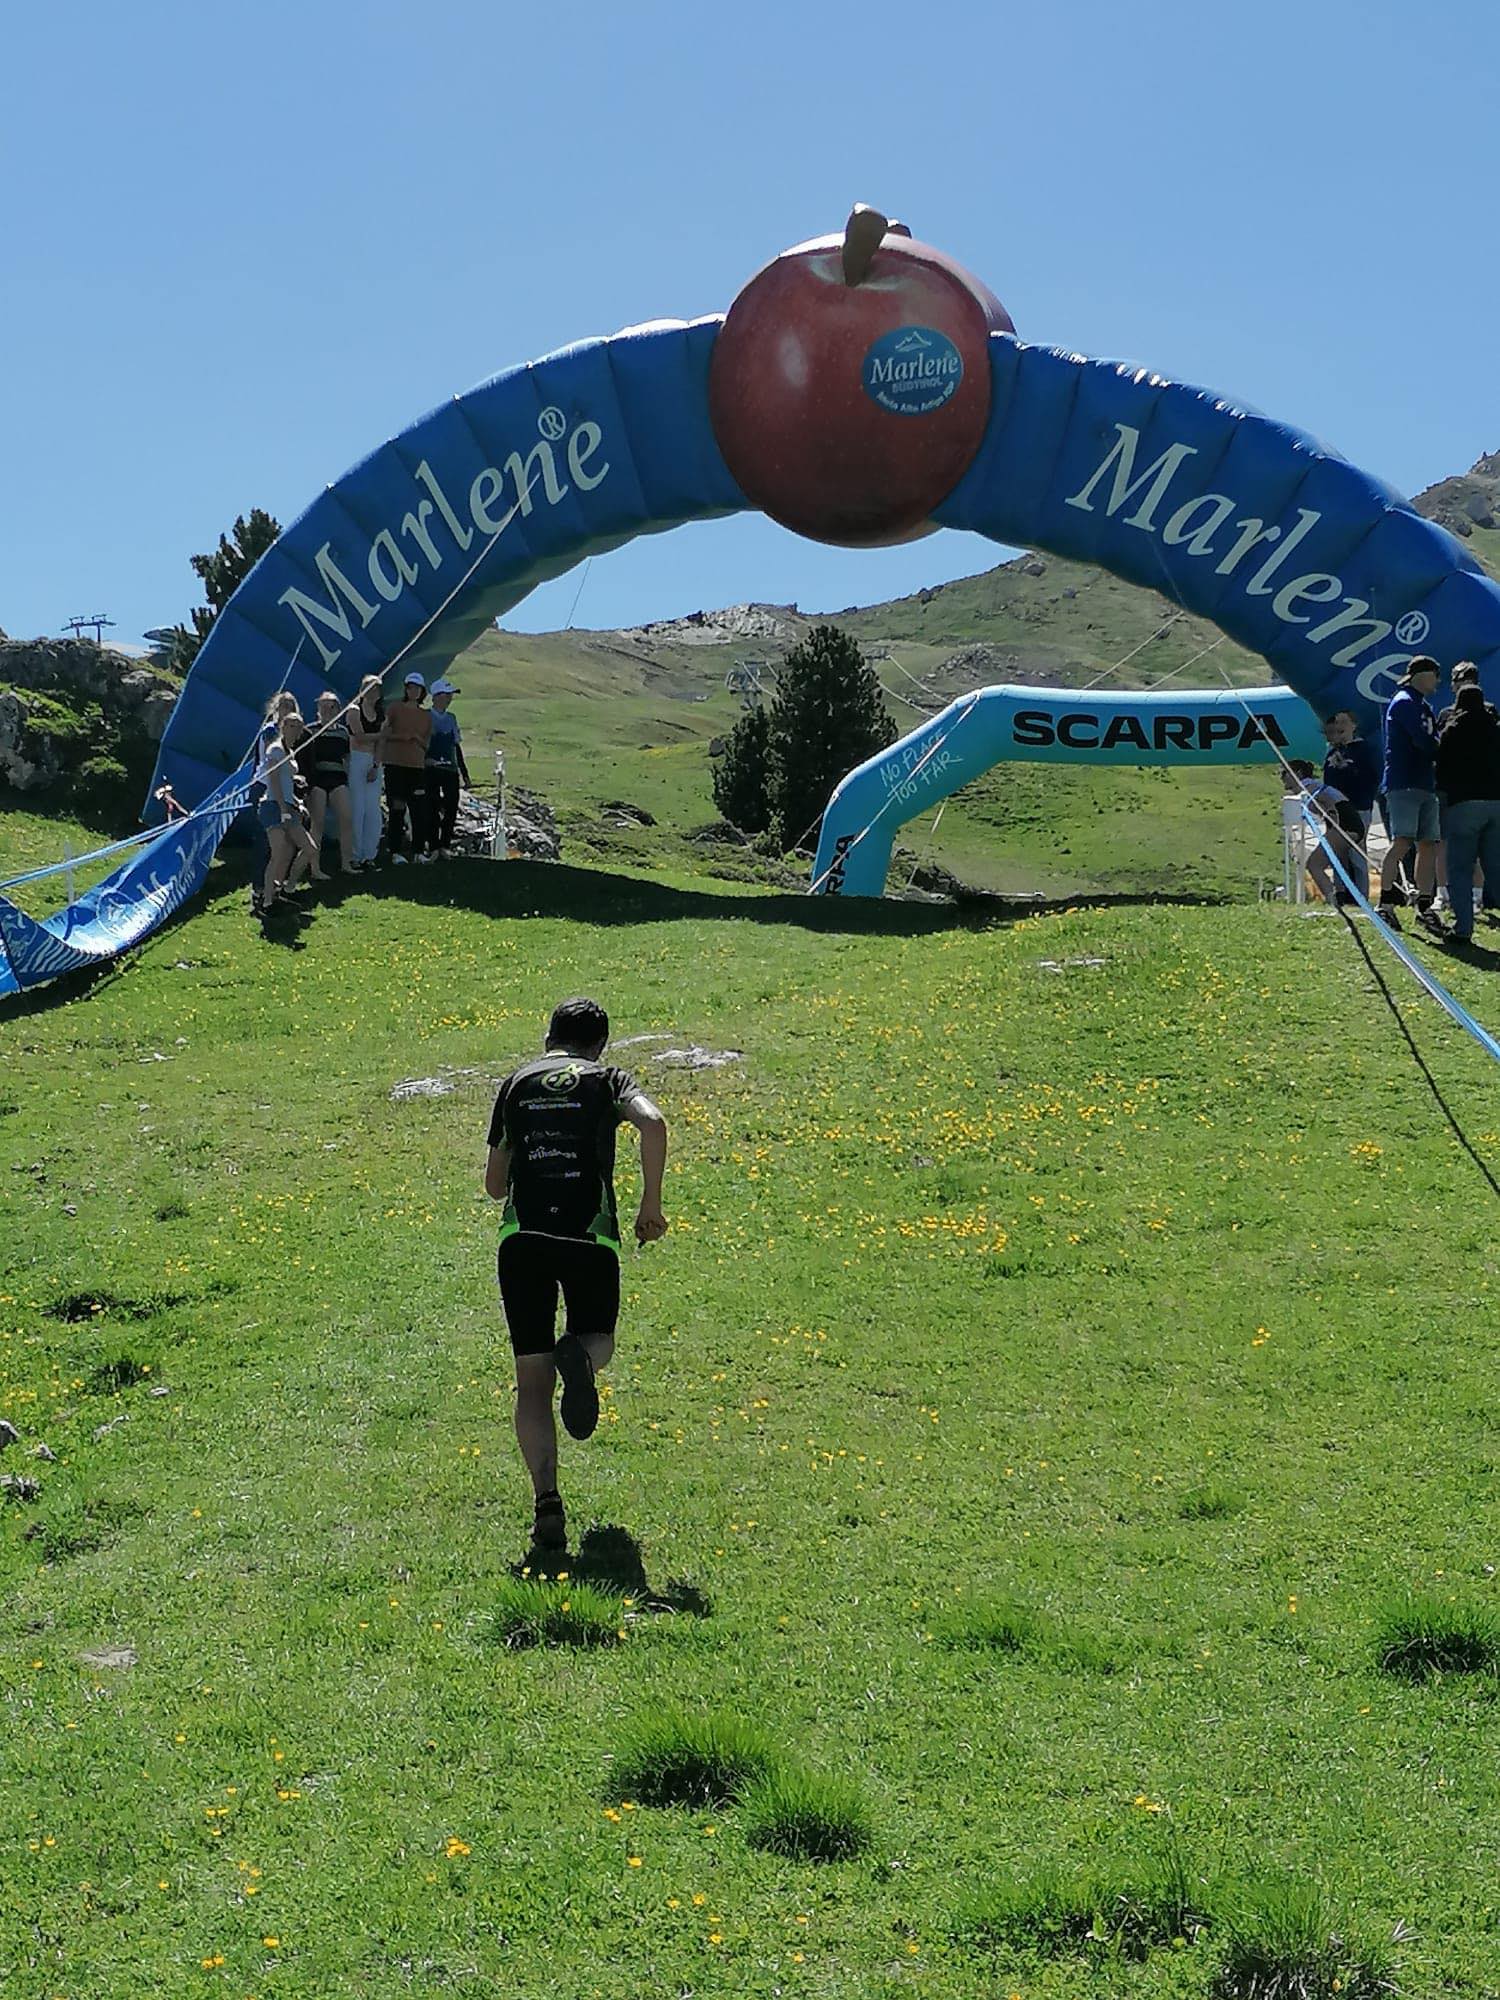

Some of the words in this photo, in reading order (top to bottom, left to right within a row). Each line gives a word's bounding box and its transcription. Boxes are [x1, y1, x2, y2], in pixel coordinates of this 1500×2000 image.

[870, 352, 959, 384] Marlene
[1013, 711, 1289, 750] SCARPA
[880, 762, 900, 787] NO
[918, 751, 963, 785] FAR
